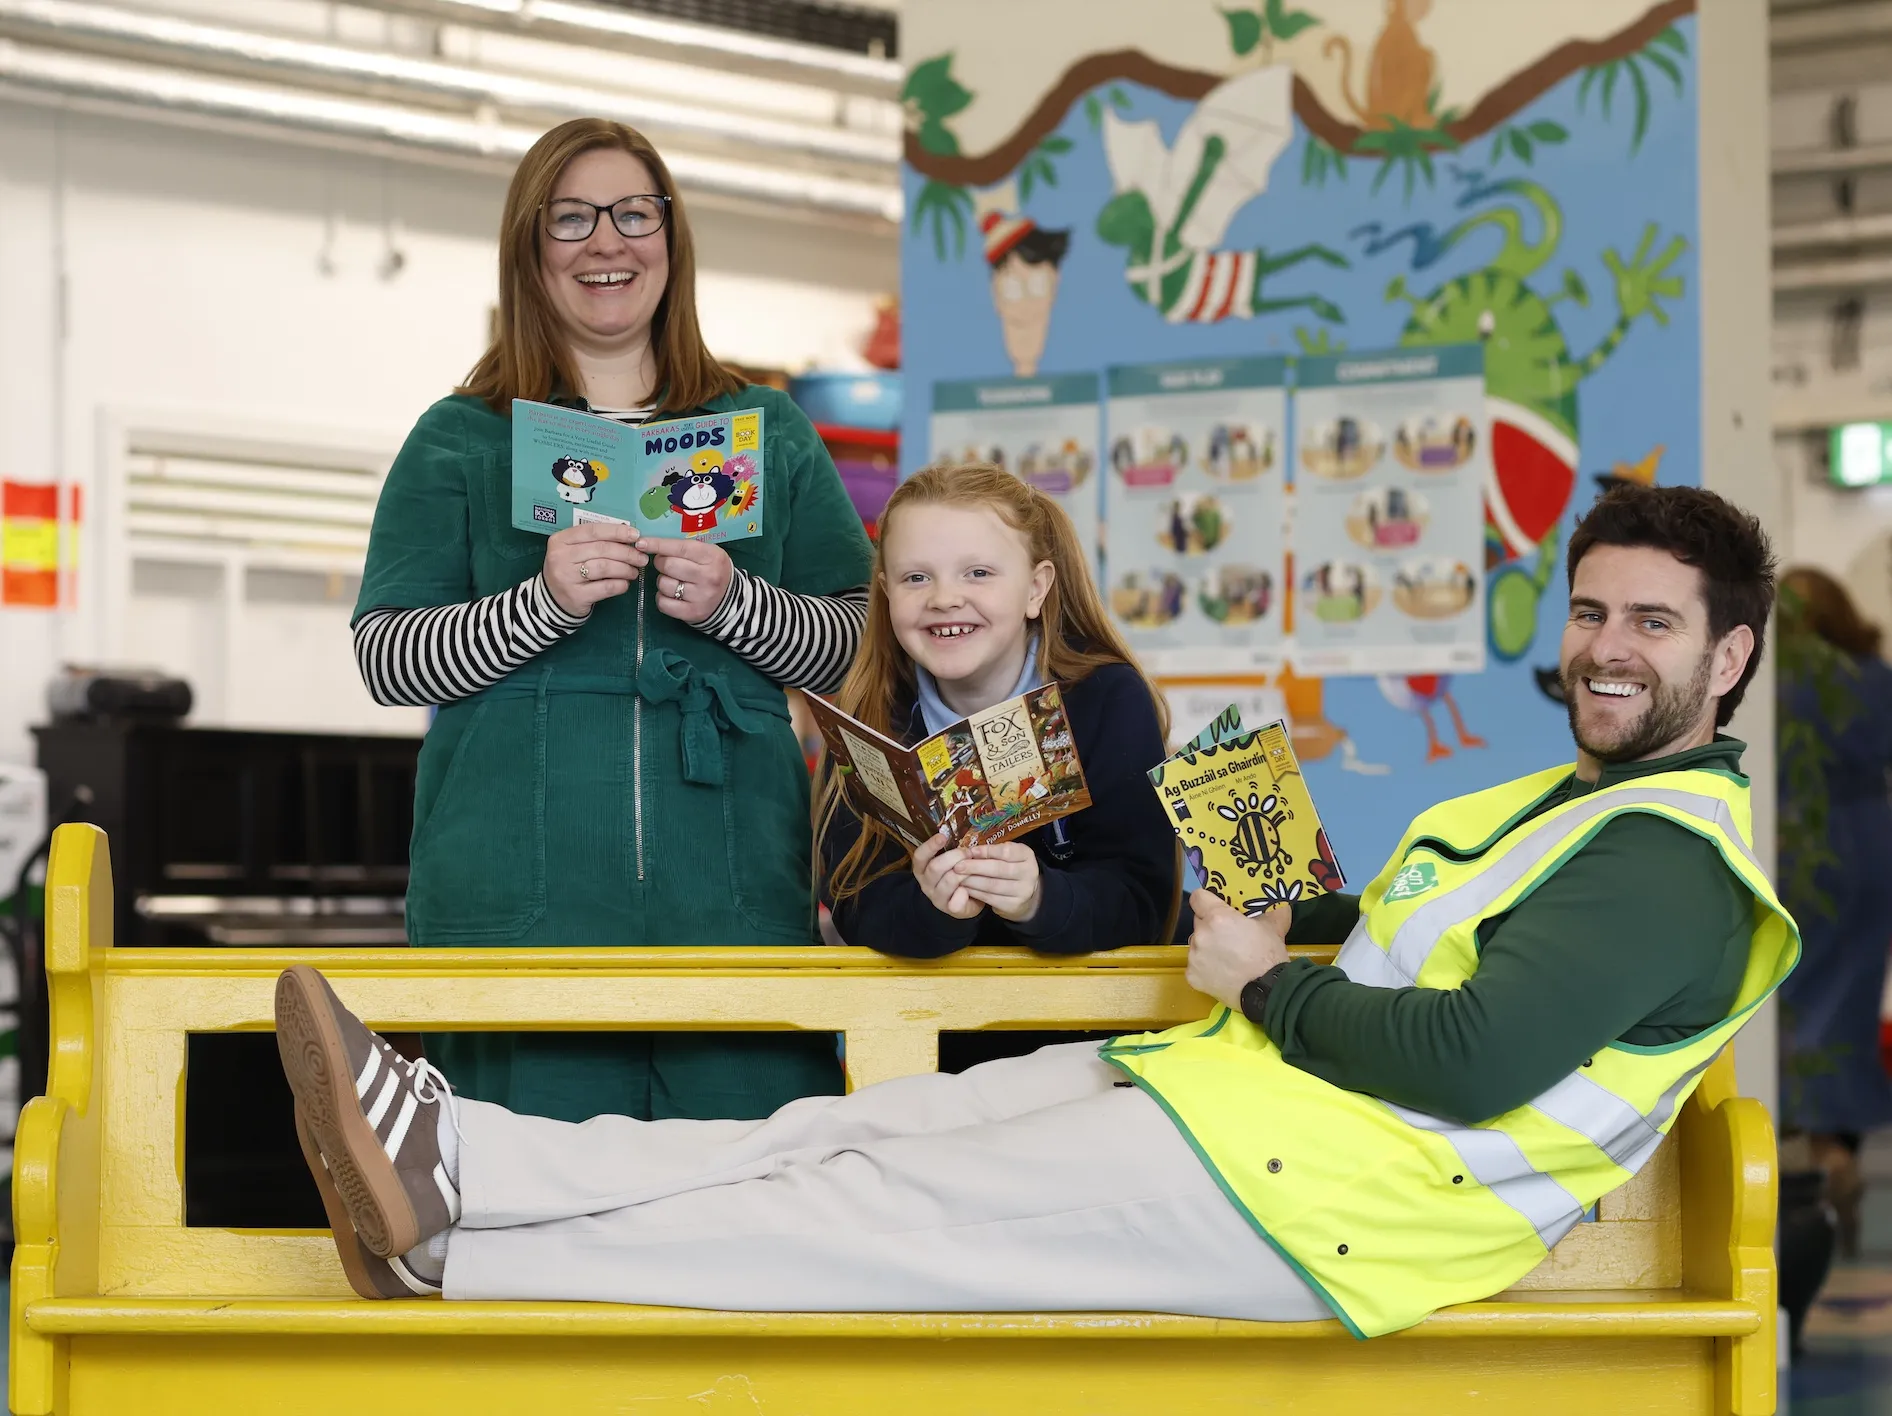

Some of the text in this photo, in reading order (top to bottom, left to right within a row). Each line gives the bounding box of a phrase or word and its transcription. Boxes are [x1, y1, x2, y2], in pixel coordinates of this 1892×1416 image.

[695, 419, 718, 429] GUIDE
[720, 417, 730, 426] TO
[645, 427, 725, 456] MOODS
[736, 429, 756, 438] BOOK
[1001, 731, 1026, 747] SON
[989, 750, 1033, 772] TAILERS
[1164, 786, 1181, 799] Ag
[1179, 769, 1217, 792] Buzzáil
[1216, 768, 1228, 779] sa
[1228, 752, 1267, 774] Ghairdín
[986, 828, 1006, 846] PADDY
